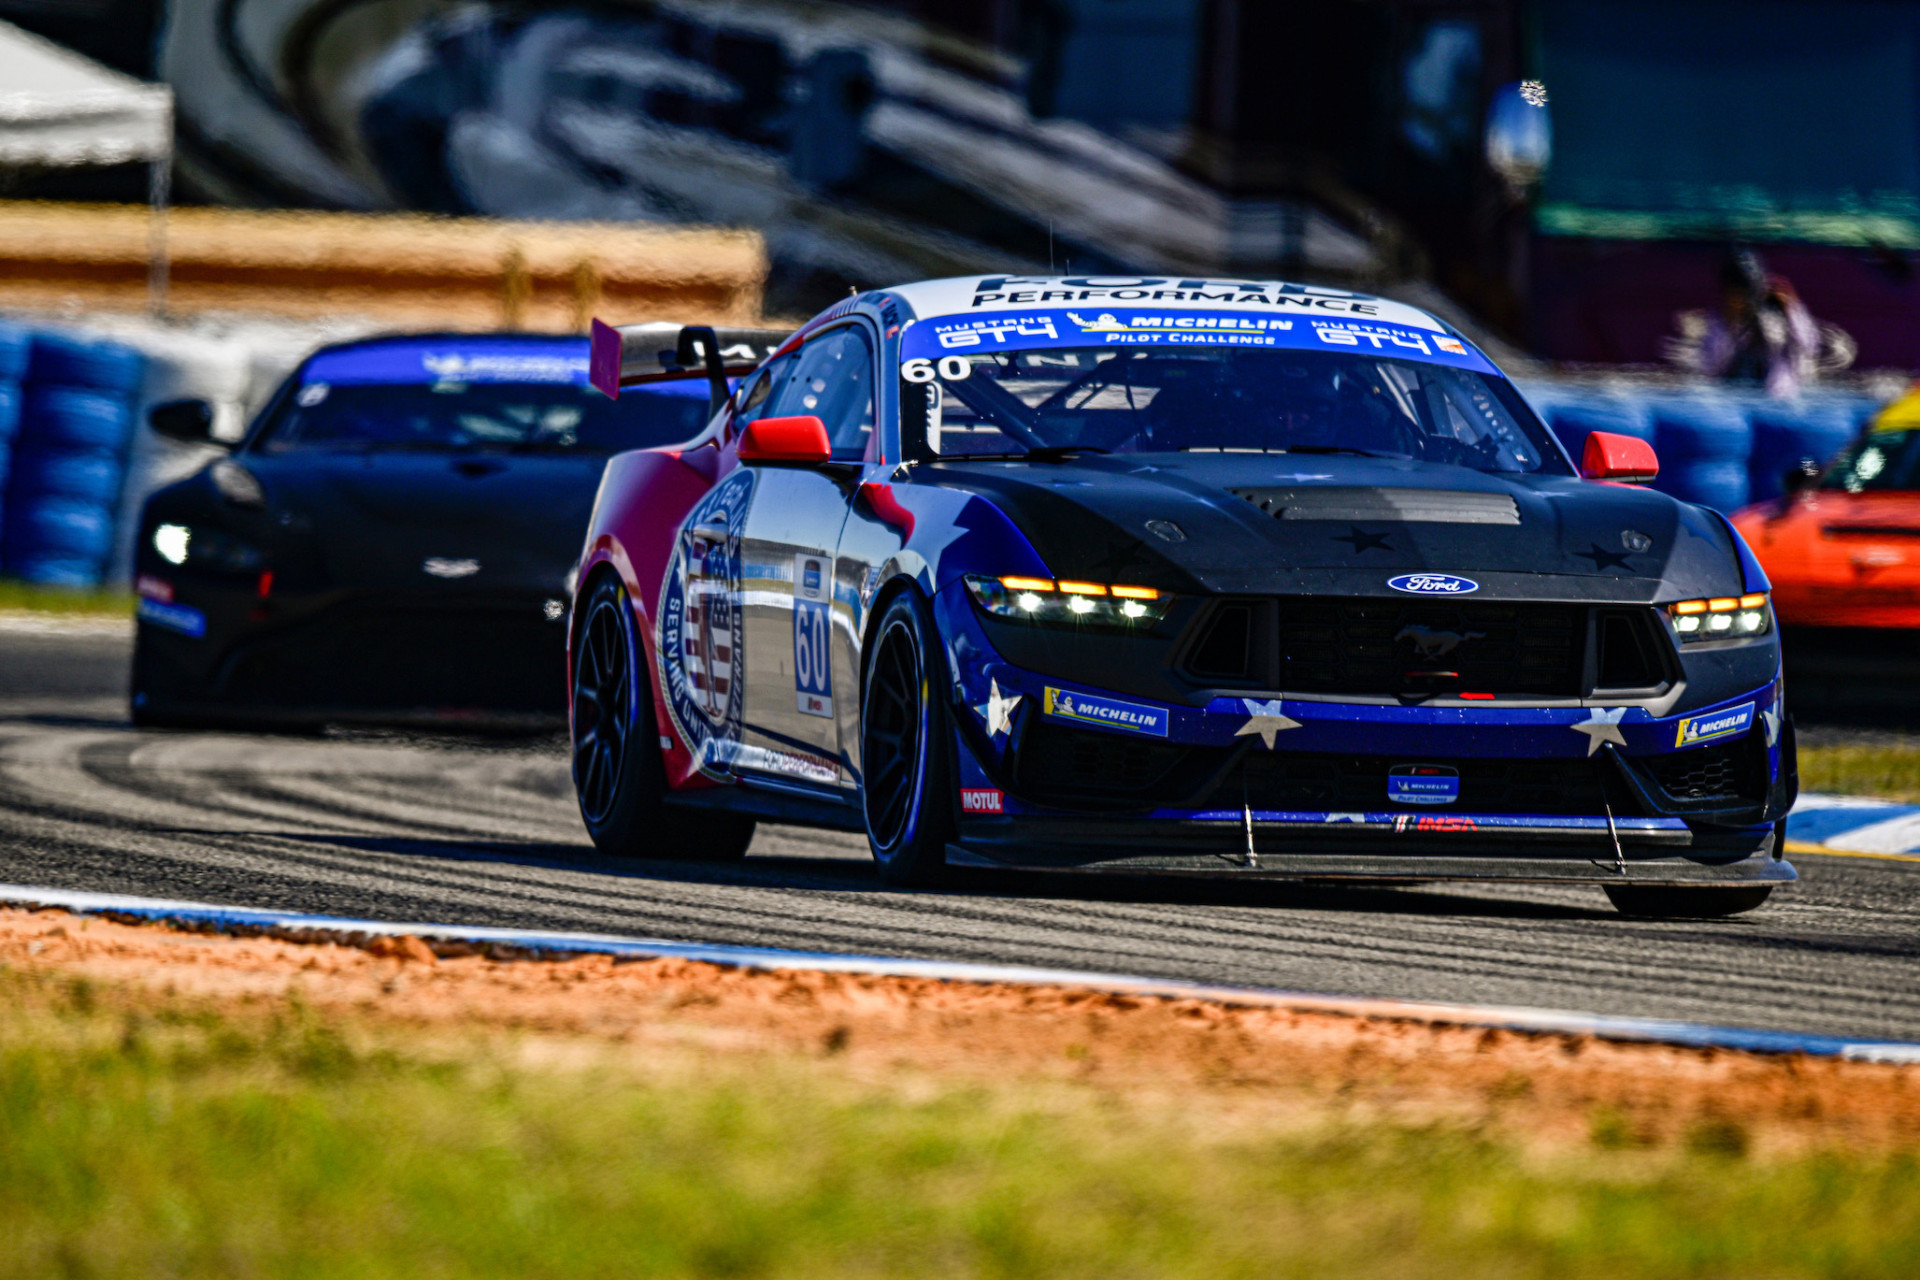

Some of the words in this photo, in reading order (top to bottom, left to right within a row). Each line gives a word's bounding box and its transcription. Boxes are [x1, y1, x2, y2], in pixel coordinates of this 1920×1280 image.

[972, 289, 1379, 316] PERFORMANCE
[935, 316, 1052, 334] MUSTANG
[1131, 316, 1294, 331] MICHELIN
[1310, 320, 1423, 340] MUSTANG
[938, 323, 1059, 348] GT4
[1105, 332, 1162, 343] PILOT
[1168, 332, 1276, 346] CHALLENGE
[1316, 327, 1432, 356] GT4
[901, 355, 971, 383] 60
[1406, 576, 1460, 592] Ford
[667, 597, 685, 702] SERVING
[795, 603, 826, 691] 60
[1077, 703, 1158, 727] MICHELIN
[1699, 712, 1748, 735] MICHELIN
[963, 791, 1001, 811] MOTUL
[1417, 816, 1478, 832] IMSA
